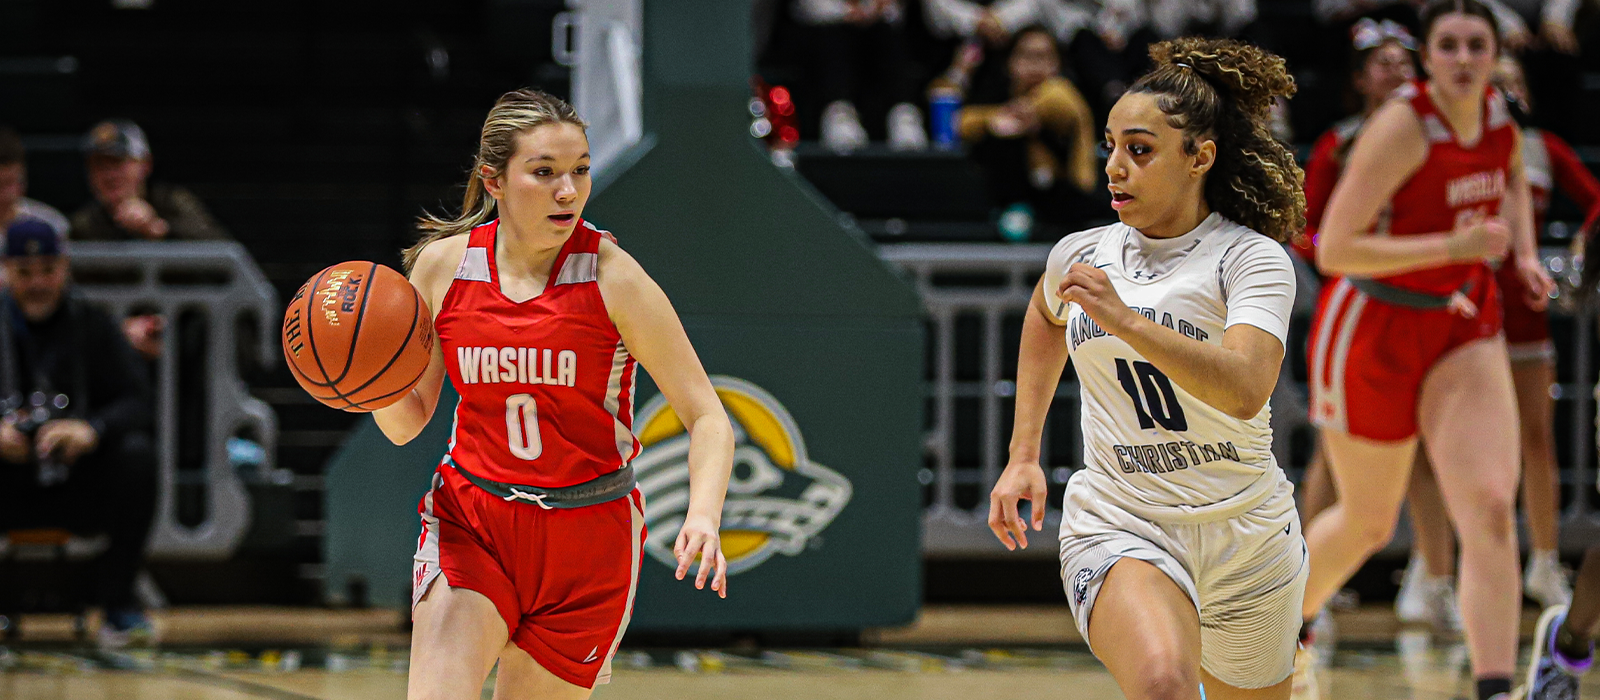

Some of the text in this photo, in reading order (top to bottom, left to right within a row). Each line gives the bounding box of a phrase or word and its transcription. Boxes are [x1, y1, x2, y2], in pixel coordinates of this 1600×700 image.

[285, 309, 304, 357] THE
[457, 346, 577, 387] WASILLA
[1114, 357, 1188, 432] 10
[505, 393, 543, 461] 0
[1113, 441, 1240, 474] CHRISTIAN
